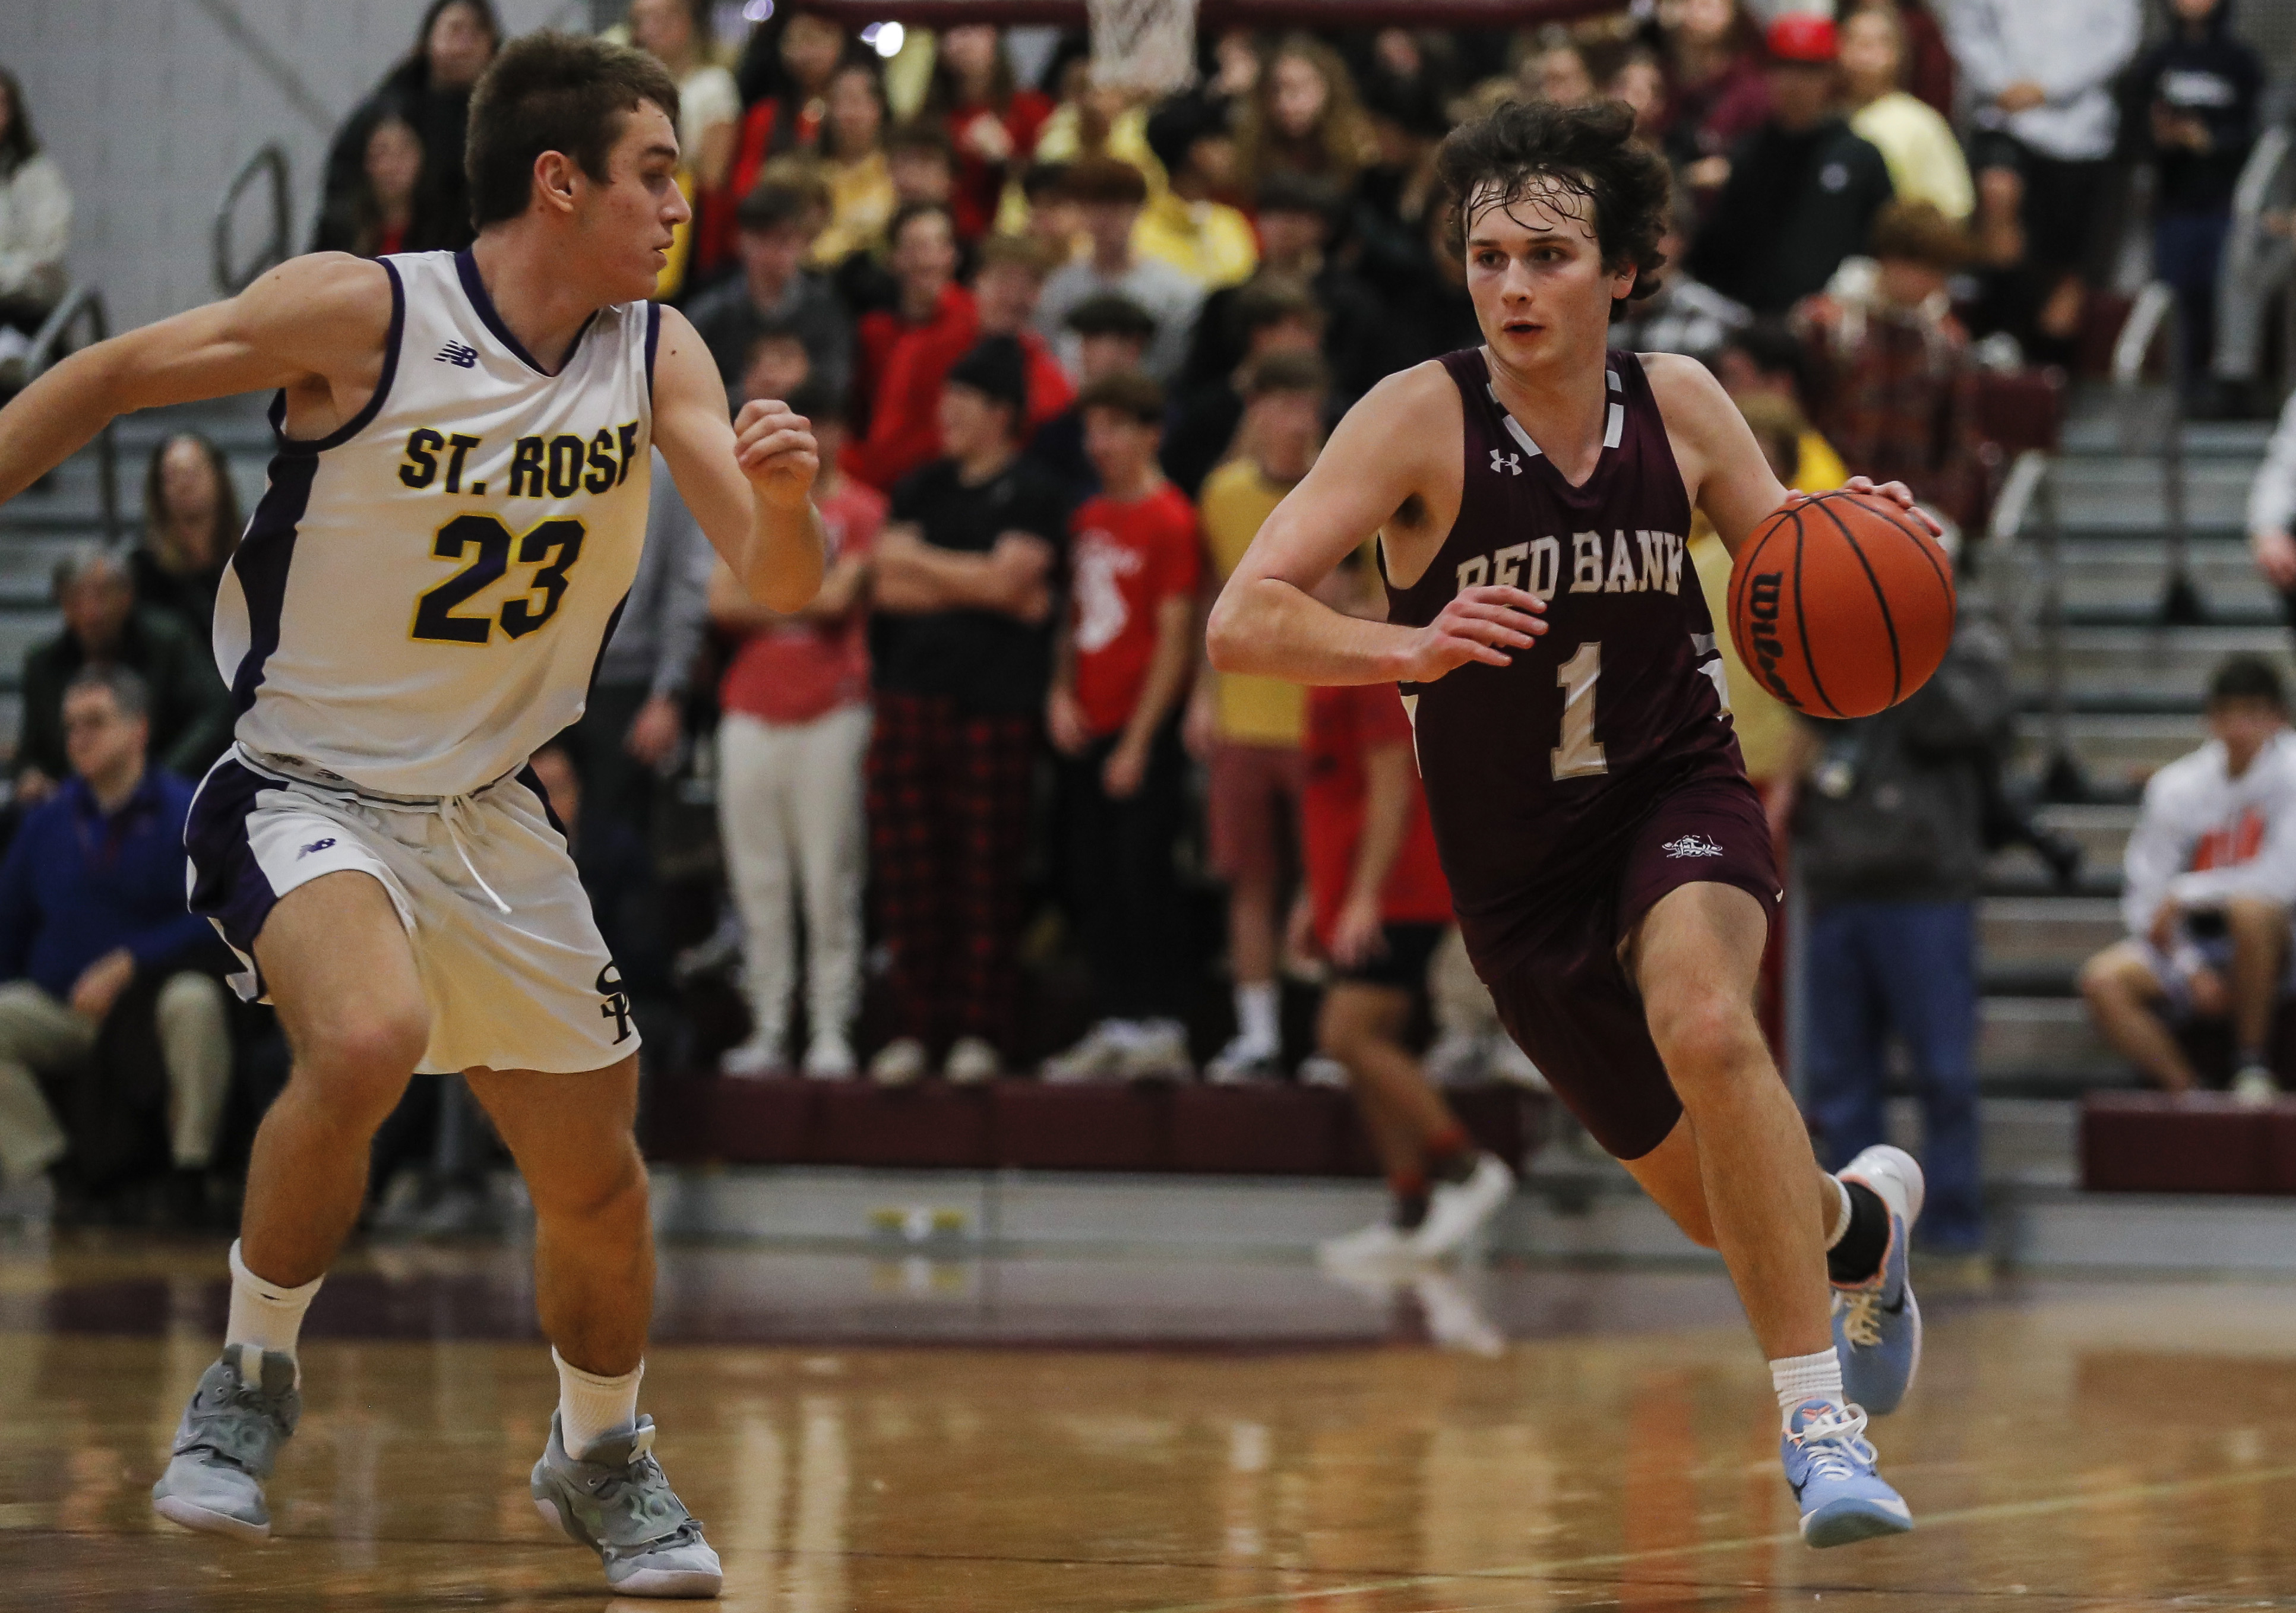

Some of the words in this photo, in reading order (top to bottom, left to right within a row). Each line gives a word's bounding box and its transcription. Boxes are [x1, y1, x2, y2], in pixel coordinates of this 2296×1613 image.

[398, 427, 487, 496] ST.
[407, 511, 589, 647] 23
[1568, 529, 1683, 596] BANK
[1550, 641, 1608, 782] 1
